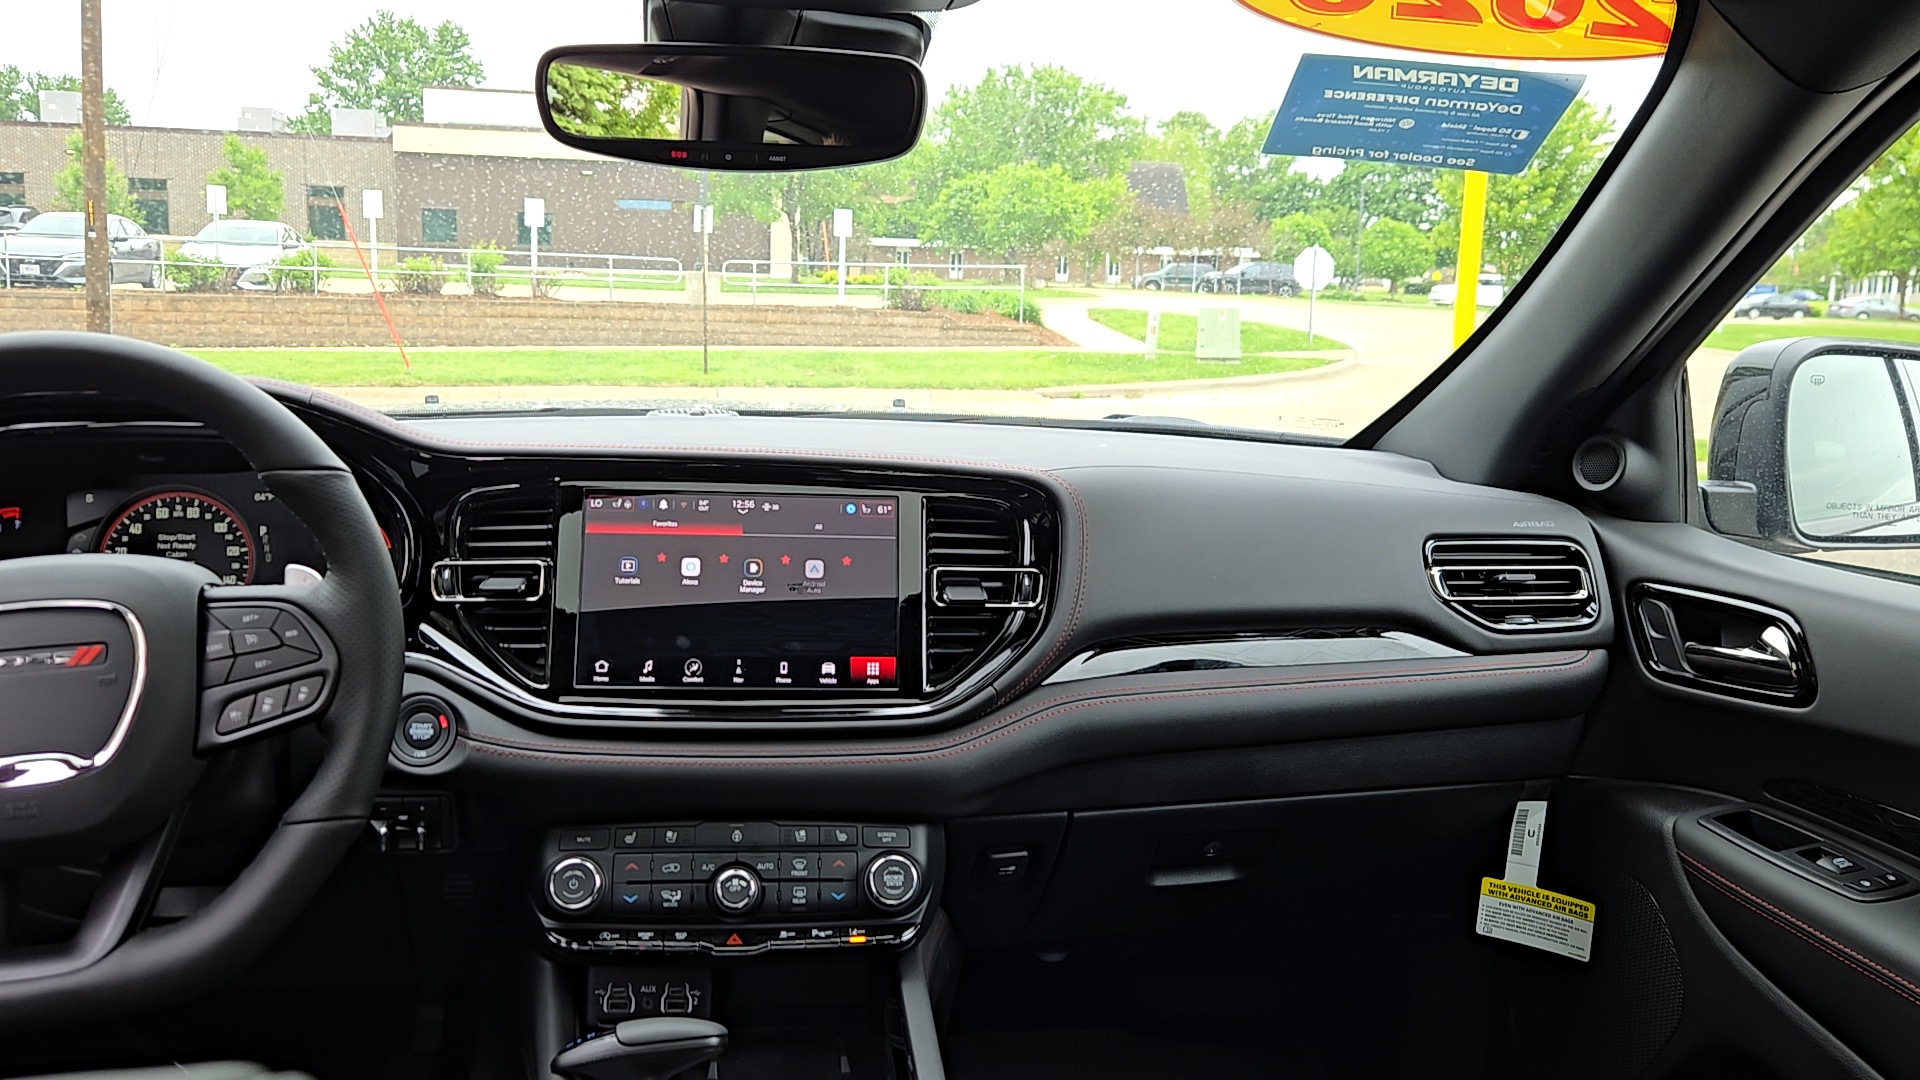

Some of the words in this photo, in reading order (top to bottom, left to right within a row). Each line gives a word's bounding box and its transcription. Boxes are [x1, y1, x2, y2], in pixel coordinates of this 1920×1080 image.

[590, 499, 603, 508] LO
[732, 500, 755, 509] 12:56
[1826, 502, 1862, 511] OBJECTS
[156, 507, 169, 519] 60
[1852, 511, 1874, 520] THAN
[1877, 512, 1897, 521] THEY
[129, 522, 142, 534] 40
[1512, 520, 1556, 528] AIRBAG
[158, 533, 197, 542] Stop/Start
[614, 577, 641, 586] Tutorials
[681, 578, 699, 586] Alexa
[742, 579, 763, 587] Device
[802, 580, 826, 588] Android
[739, 586, 766, 595] Manager
[1527, 829, 1536, 838] U
[702, 863, 715, 871] A/C
[1488, 881, 1507, 891] THIS
[1508, 885, 1541, 898] VEHICLE
[1542, 893, 1550, 901] IS
[1552, 896, 1590, 912] EQUIPPED
[1487, 888, 1508, 898] WITH
[1509, 893, 1553, 908] ADVANCED
[1553, 903, 1567, 913] AIR
[1568, 907, 1589, 919] BAGS
[1526, 907, 1552, 918] ADVANCED
[640, 985, 656, 993] AUX
